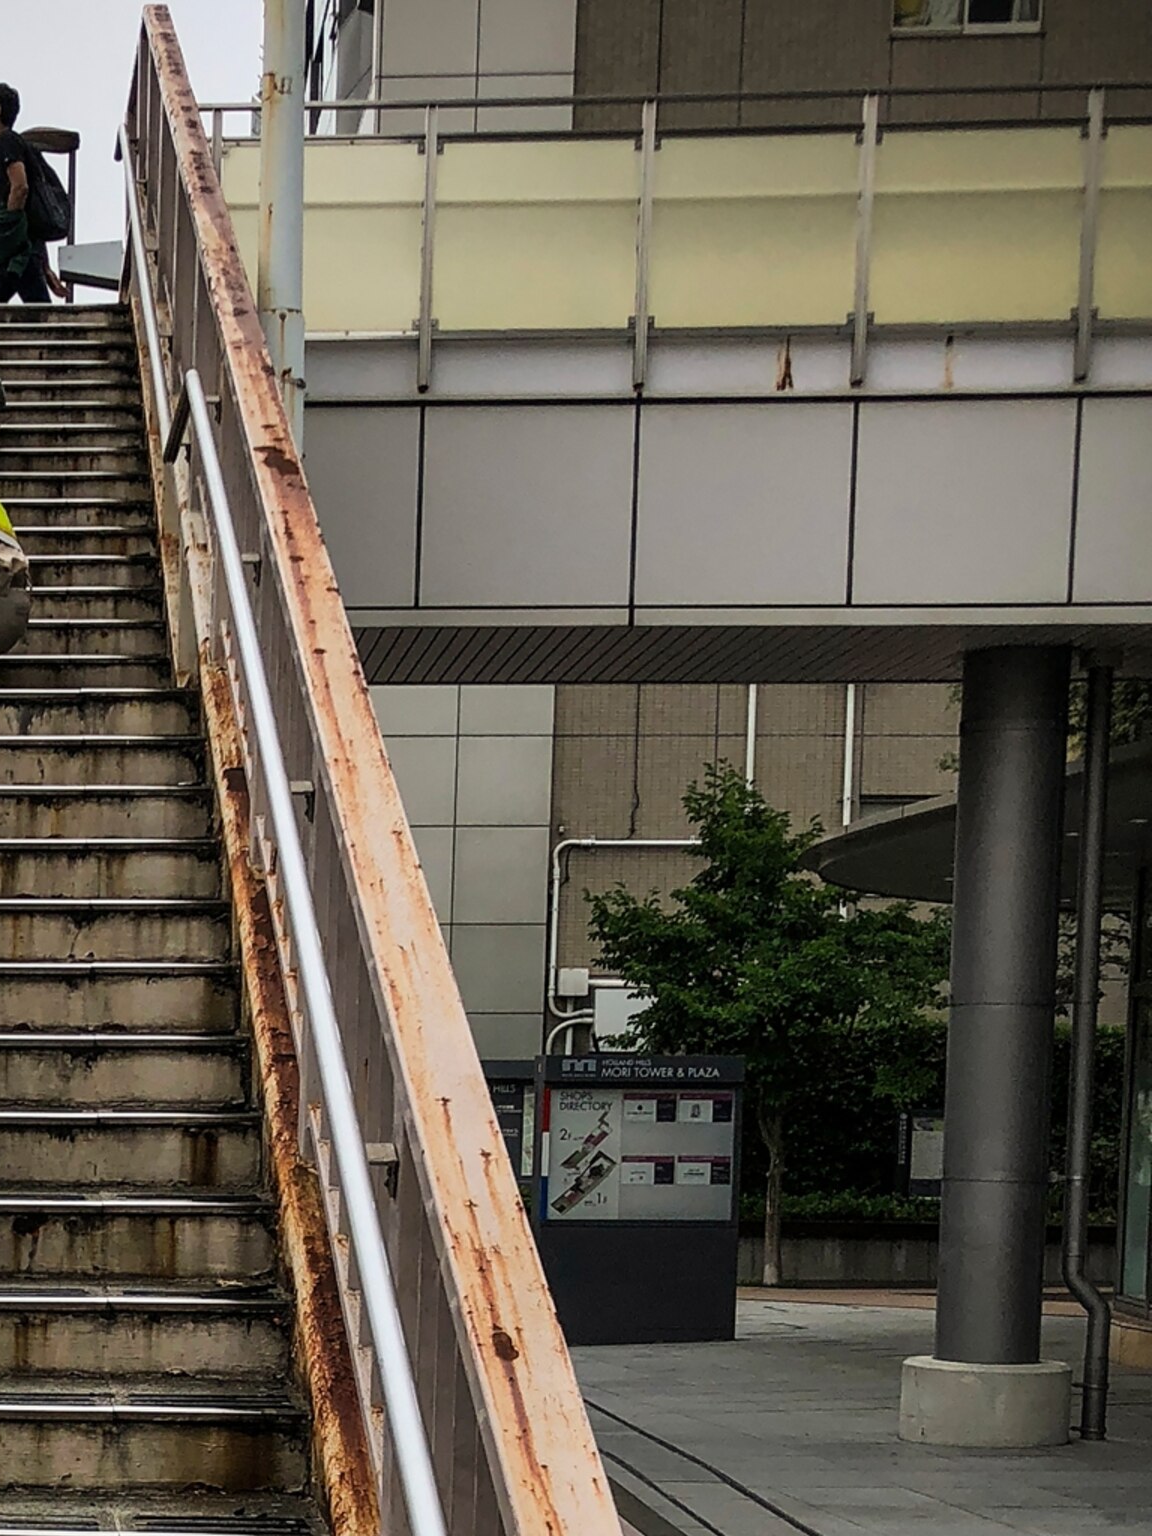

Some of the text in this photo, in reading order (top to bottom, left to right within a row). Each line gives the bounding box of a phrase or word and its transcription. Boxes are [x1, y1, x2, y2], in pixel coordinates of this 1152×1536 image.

[601, 1067, 720, 1078] MORI TOWER & PLAZA
[560, 1091, 593, 1101] SHOPS
[559, 1101, 613, 1111] DIRECTORY
